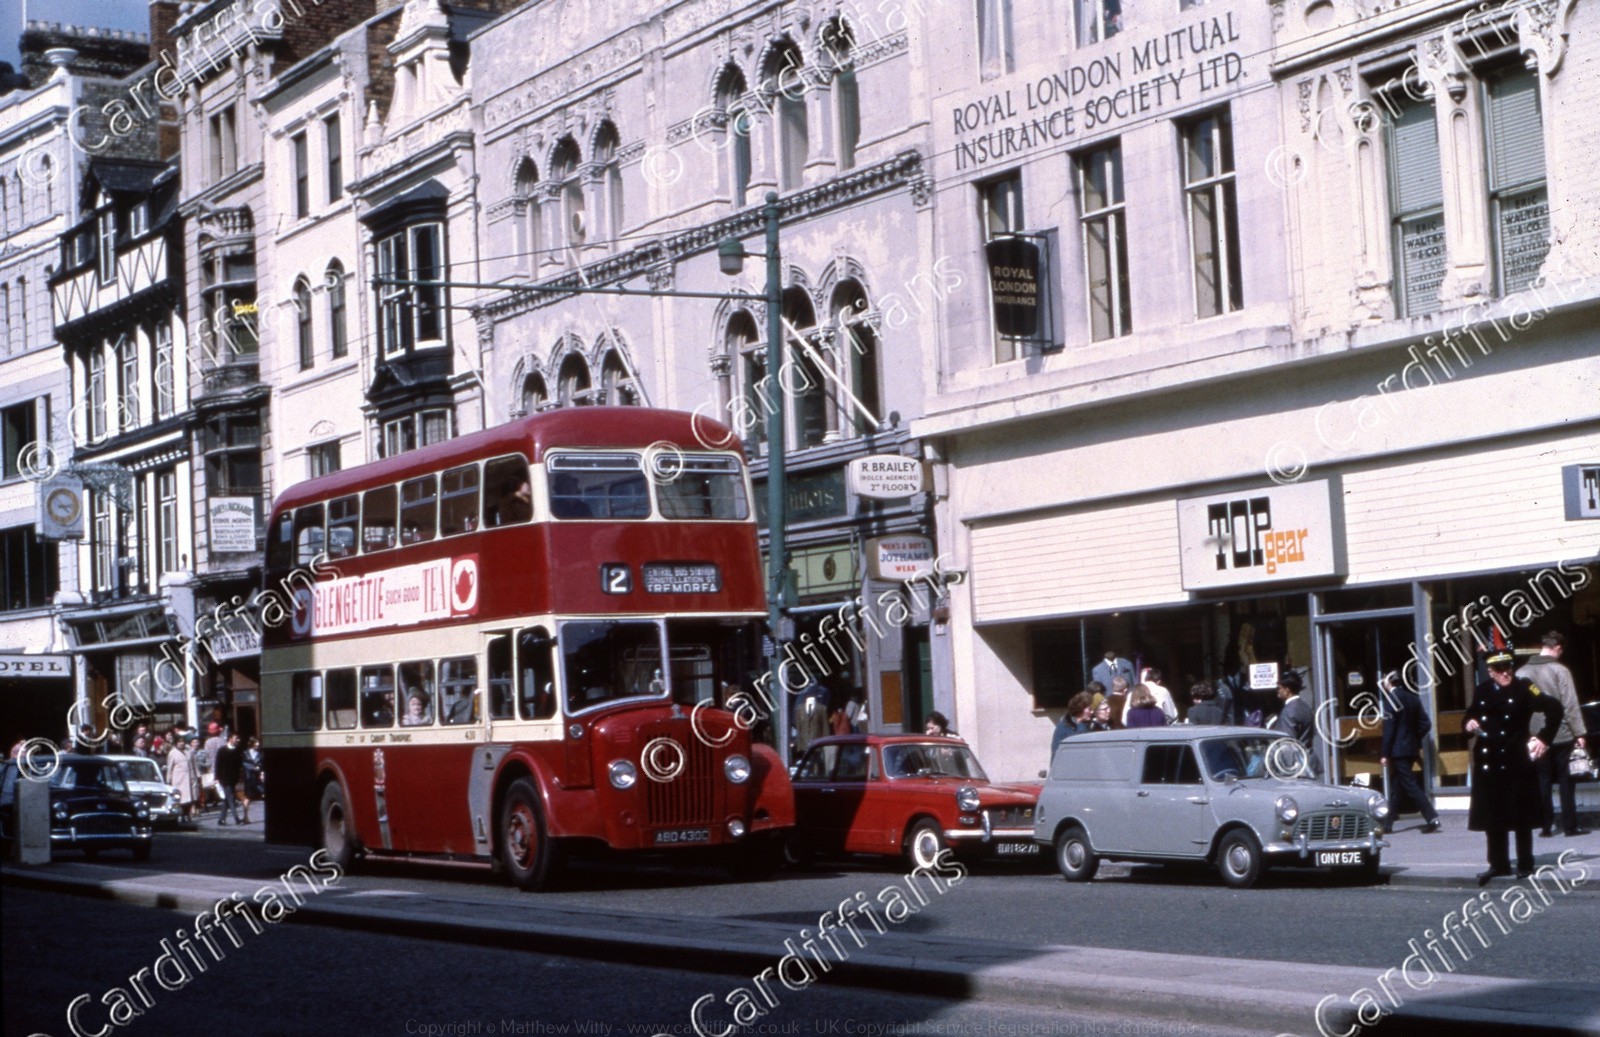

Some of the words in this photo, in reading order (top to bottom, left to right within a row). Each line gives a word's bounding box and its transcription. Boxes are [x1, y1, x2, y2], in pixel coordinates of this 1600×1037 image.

[953, 89, 1017, 135] ROYAL
[1026, 52, 1122, 111] LONDON
[1132, 11, 1240, 75] MUTUAL
[955, 106, 1075, 171] INSURANCE
[1085, 68, 1187, 130] SOCIETY
[1199, 51, 1249, 93] LTD.
[994, 266, 1034, 280] ROYAL
[993, 280, 1037, 293] LONDON
[994, 295, 1037, 306] INSURANCE
[862, 462, 869, 472] R
[872, 462, 916, 472] BRAILEY
[882, 483, 909, 491] FLOOR
[1207, 496, 1272, 571] TOP
[1264, 528, 1308, 575] gear
[881, 551, 930, 562] JOTHAMS
[895, 564, 917, 572] WEAR
[645, 583, 718, 593] TREMORFA
[315, 576, 385, 629] GLENGETTIE
[385, 589, 401, 605] SUCH
[403, 586, 420, 602] GOOD
[422, 565, 446, 614] TEA
[1320, 852, 1341, 864] ONY
[1341, 851, 1362, 863] 67E
